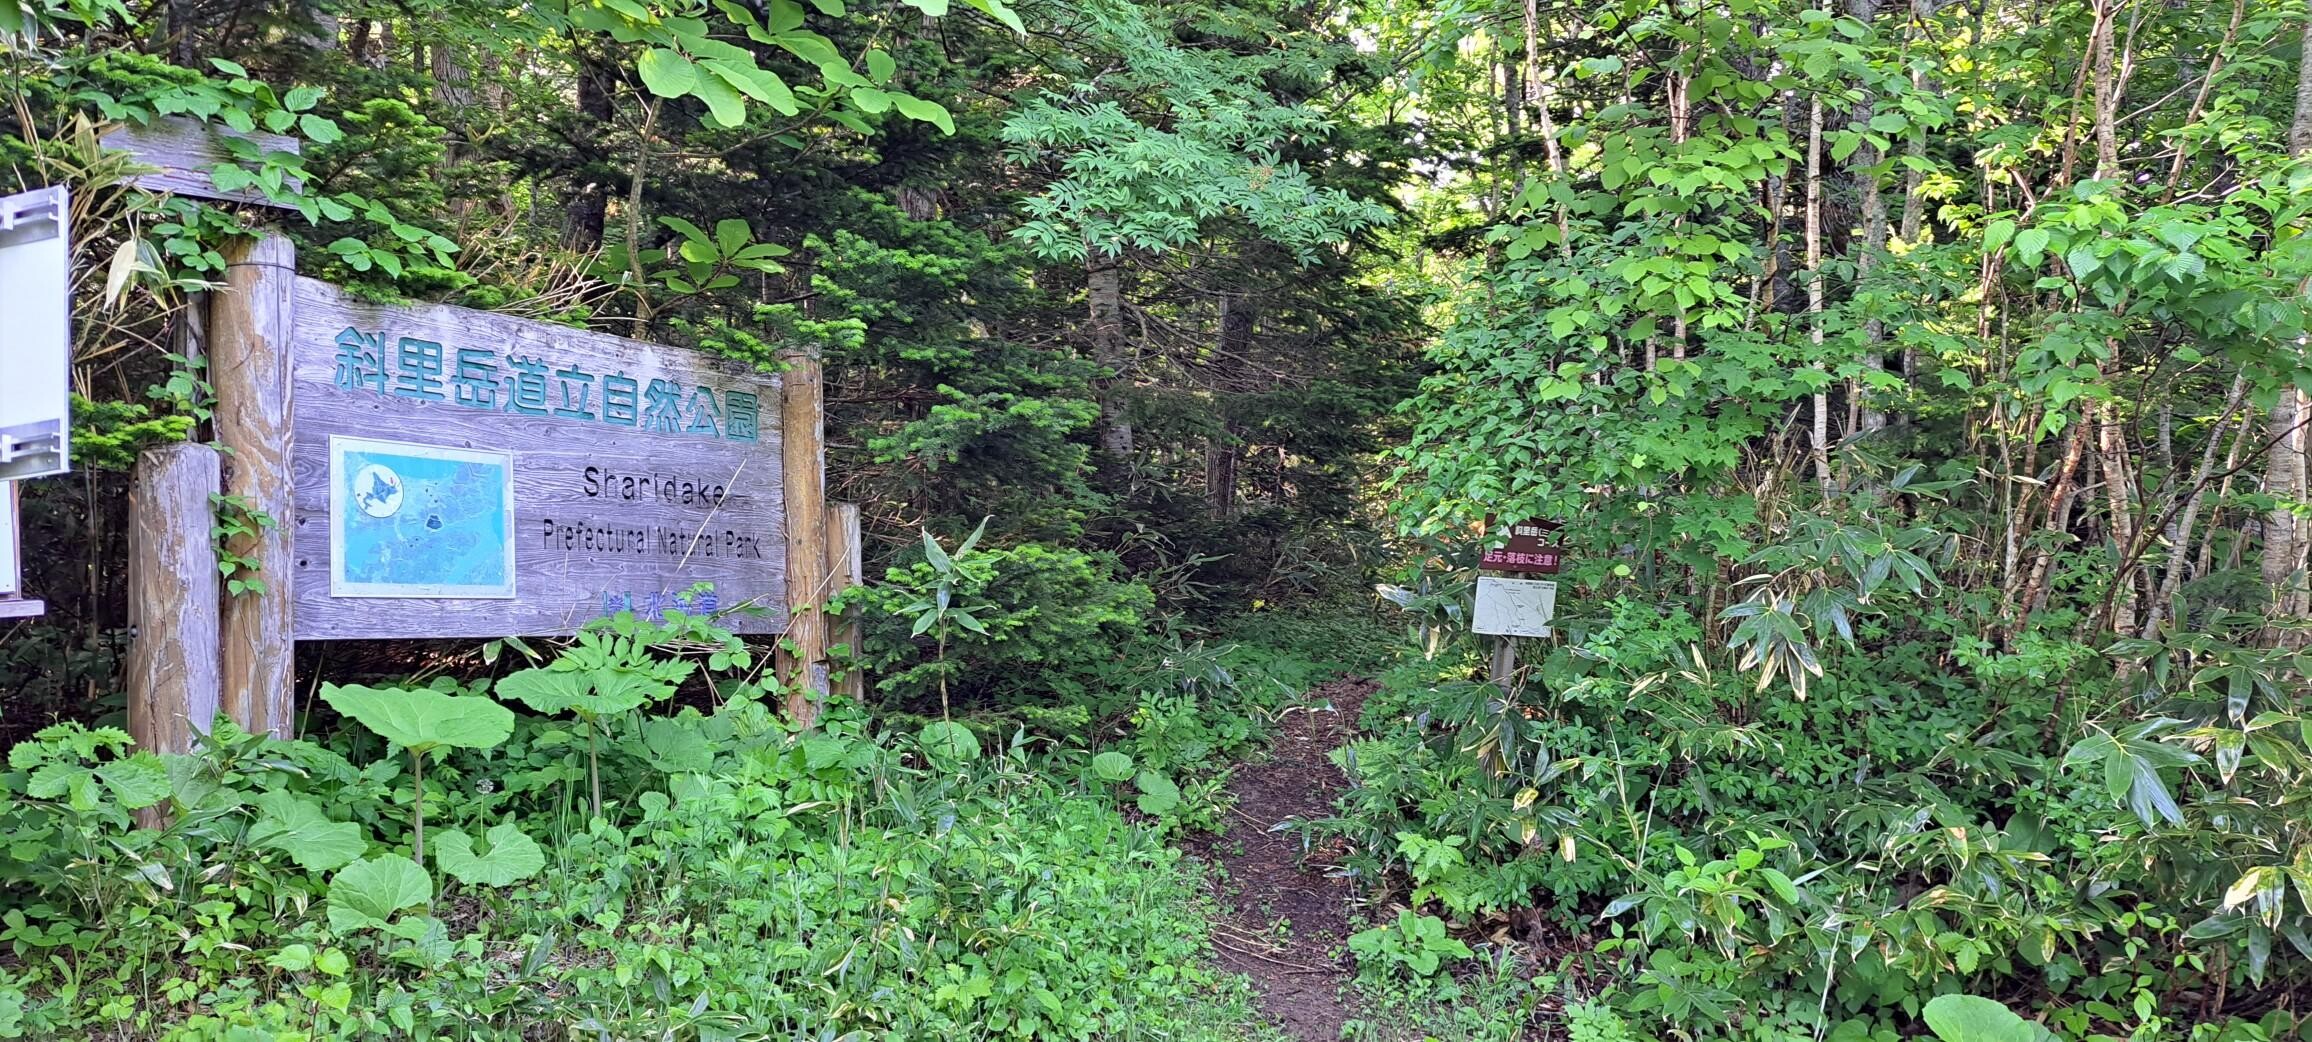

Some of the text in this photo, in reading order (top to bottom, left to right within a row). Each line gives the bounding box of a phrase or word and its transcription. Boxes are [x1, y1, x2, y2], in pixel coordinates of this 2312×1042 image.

[334, 325, 759, 444] 斜里岳道立自然公園
[584, 466, 725, 507] Sharidake
[543, 518, 761, 559] Prefectural Natural Park
